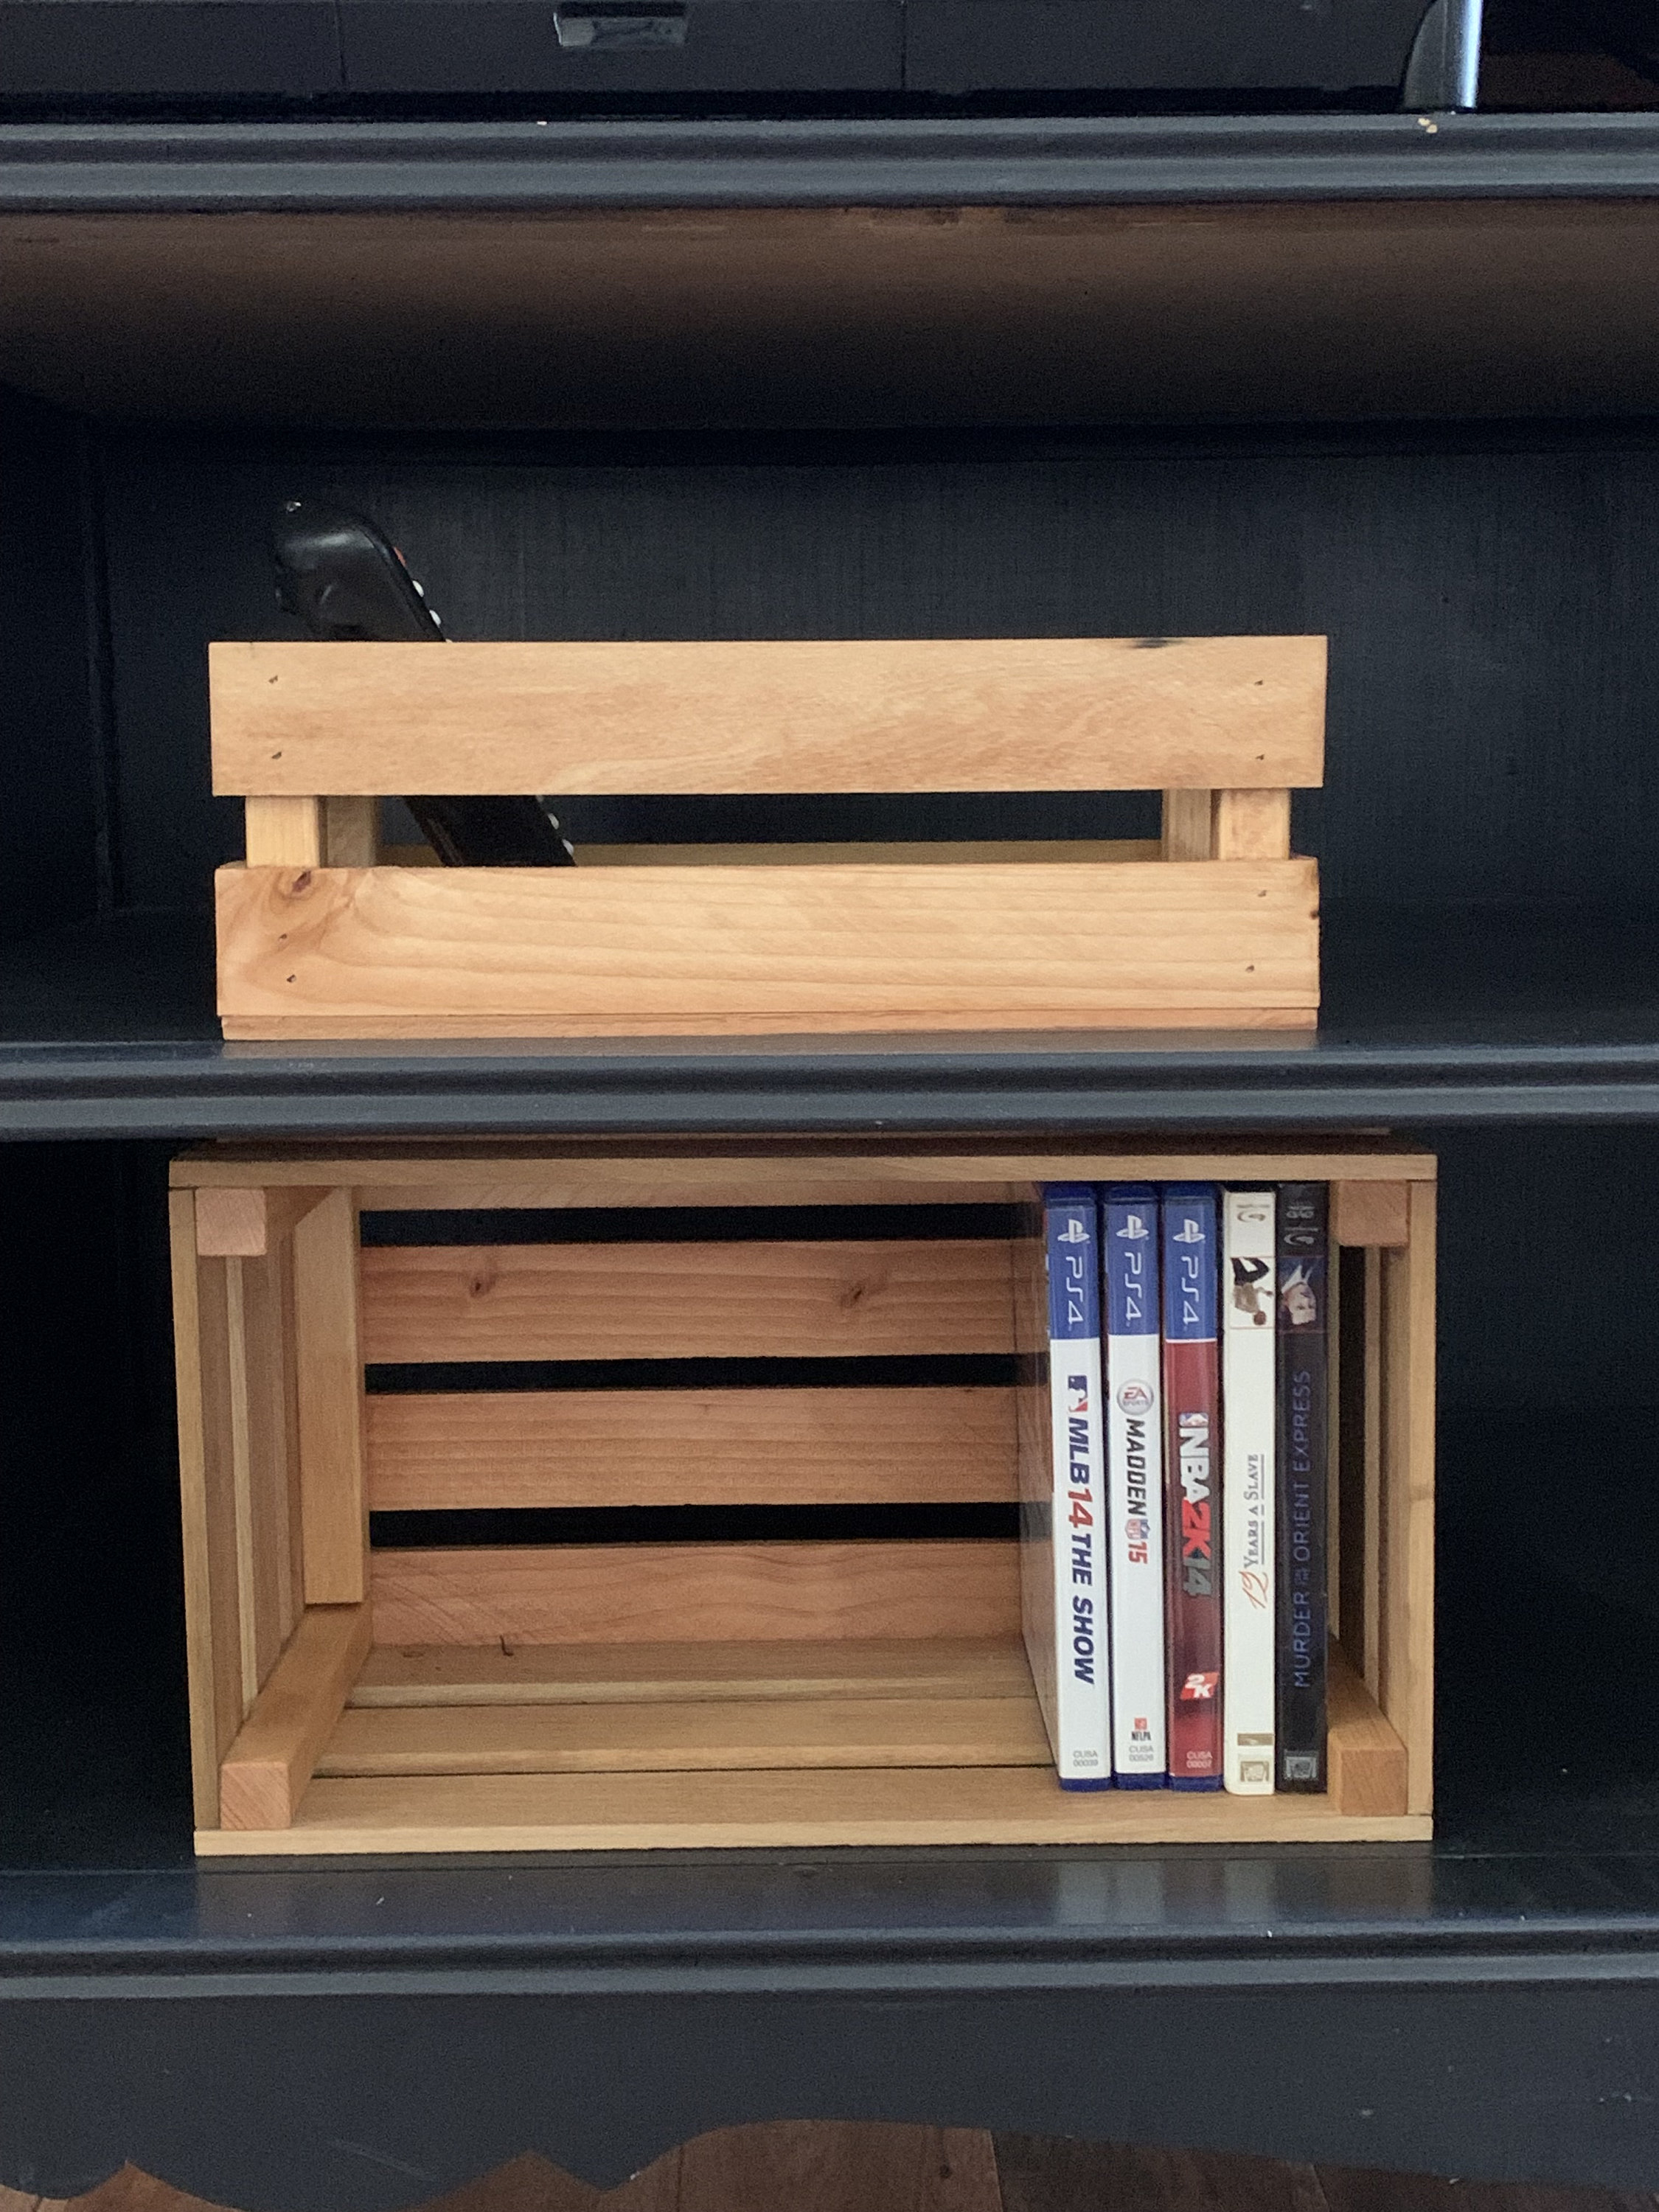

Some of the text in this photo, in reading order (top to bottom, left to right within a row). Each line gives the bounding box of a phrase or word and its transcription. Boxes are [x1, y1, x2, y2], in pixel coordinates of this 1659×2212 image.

[1065, 1256, 1083, 1325] PS4
[1124, 1252, 1141, 1321] PS4
[1181, 1256, 1200, 1325] PS4
[1124, 1386, 1147, 1399] EA
[1293, 1371, 1311, 1472] EXPRESS
[1126, 1418, 1147, 1516] MADDEN
[1068, 1416, 1095, 1685] MLB 14 THE SHOW
[1128, 1541, 1148, 1565] 15
[1293, 1481, 1311, 1562] ORIENT
[1238, 1571, 1269, 1610] 12
[1294, 1591, 1312, 1688] MURDER
[1184, 1673, 1213, 1698] 2K
[1073, 1750, 1098, 1759] CUSA
[1129, 1745, 1154, 1753] CUSA
[1186, 1751, 1214, 1760] CUSA
